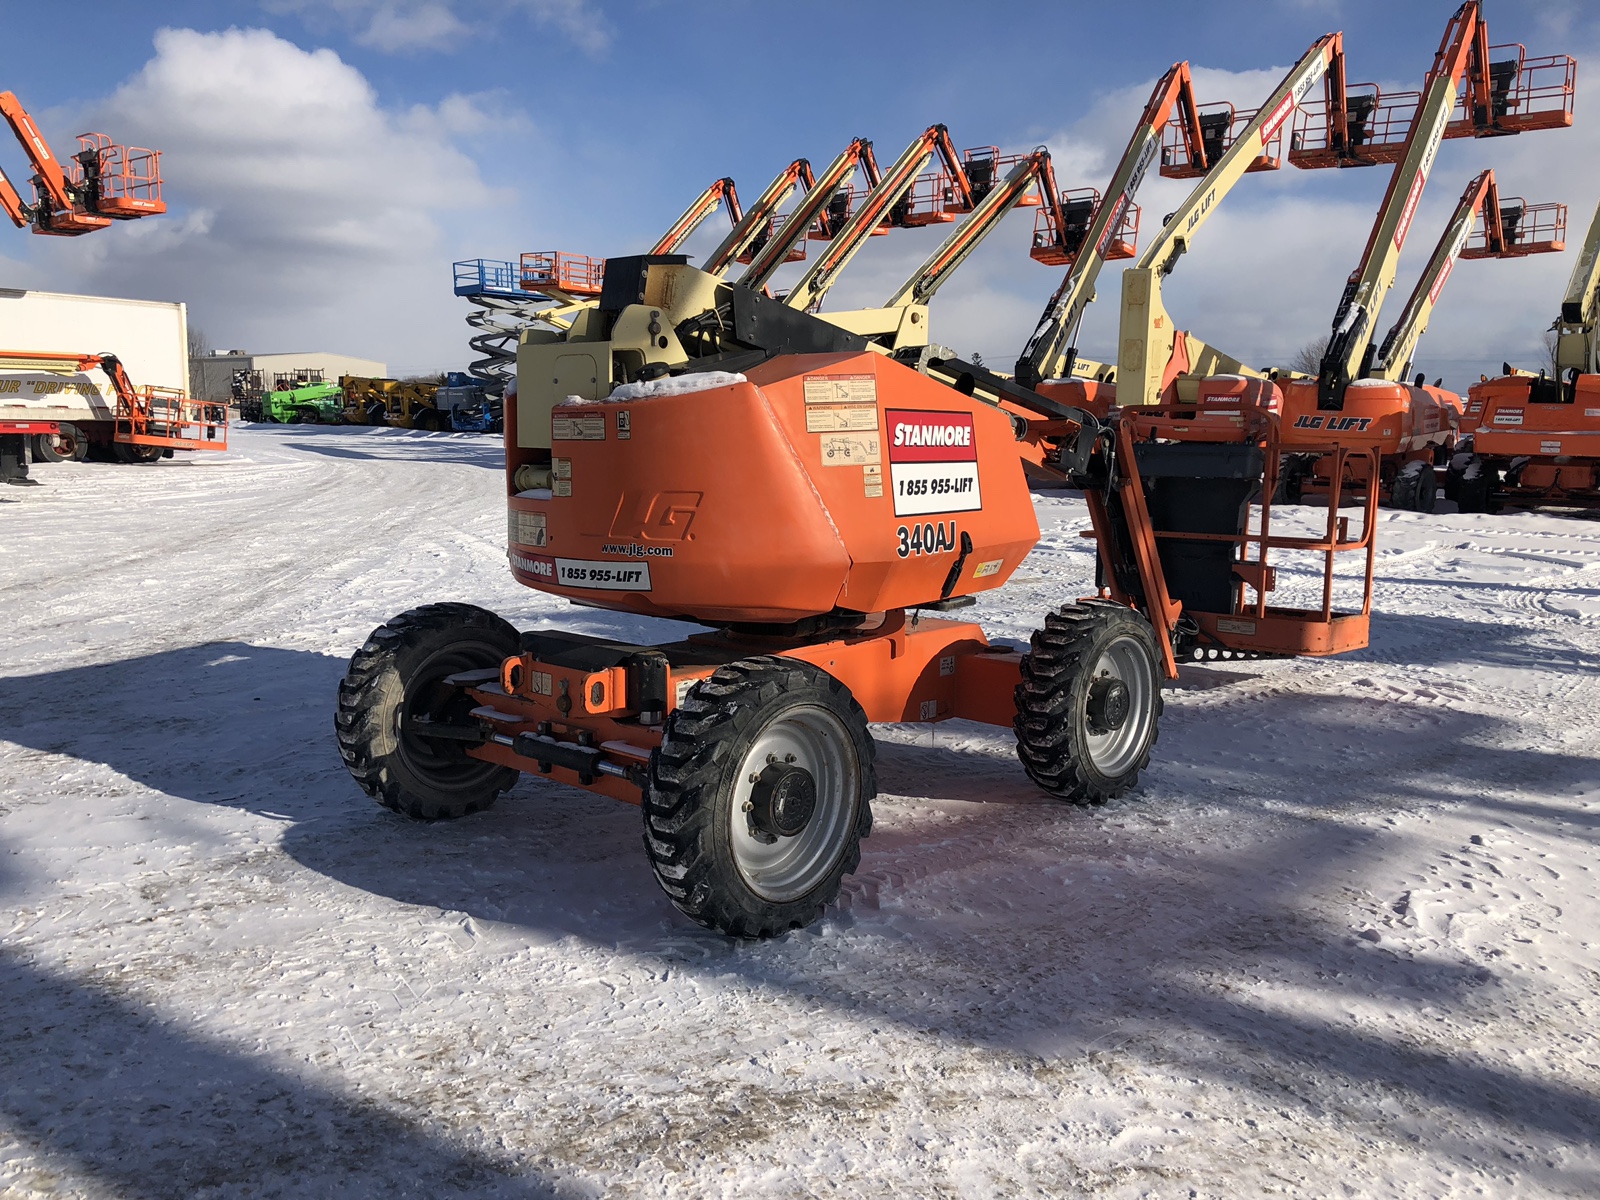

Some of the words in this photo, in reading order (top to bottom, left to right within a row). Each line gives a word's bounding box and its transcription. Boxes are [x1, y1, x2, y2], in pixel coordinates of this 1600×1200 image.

[1187, 208, 1199, 233] JLG
[1201, 188, 1216, 215] LIFT
[1100, 197, 1127, 254] STANMORE
[1370, 277, 1382, 315] LIFT
[1054, 327, 1065, 354] JLG
[1065, 297, 1078, 329] LIFT
[1077, 363, 1090, 371] LIFT
[893, 422, 971, 447] STANMORE
[1293, 415, 1325, 429] JLG
[1325, 417, 1373, 431] LIFT
[899, 480, 904, 496] 1
[907, 479, 928, 496] 855
[931, 477, 973, 494] 955-LIFT
[602, 543, 674, 558] www.jlg.com
[897, 521, 956, 558] 340AJ
[511, 553, 552, 576] STANMORE
[561, 567, 566, 578] 1
[568, 568, 587, 580] 855
[589, 569, 642, 582] 955-LIFT
